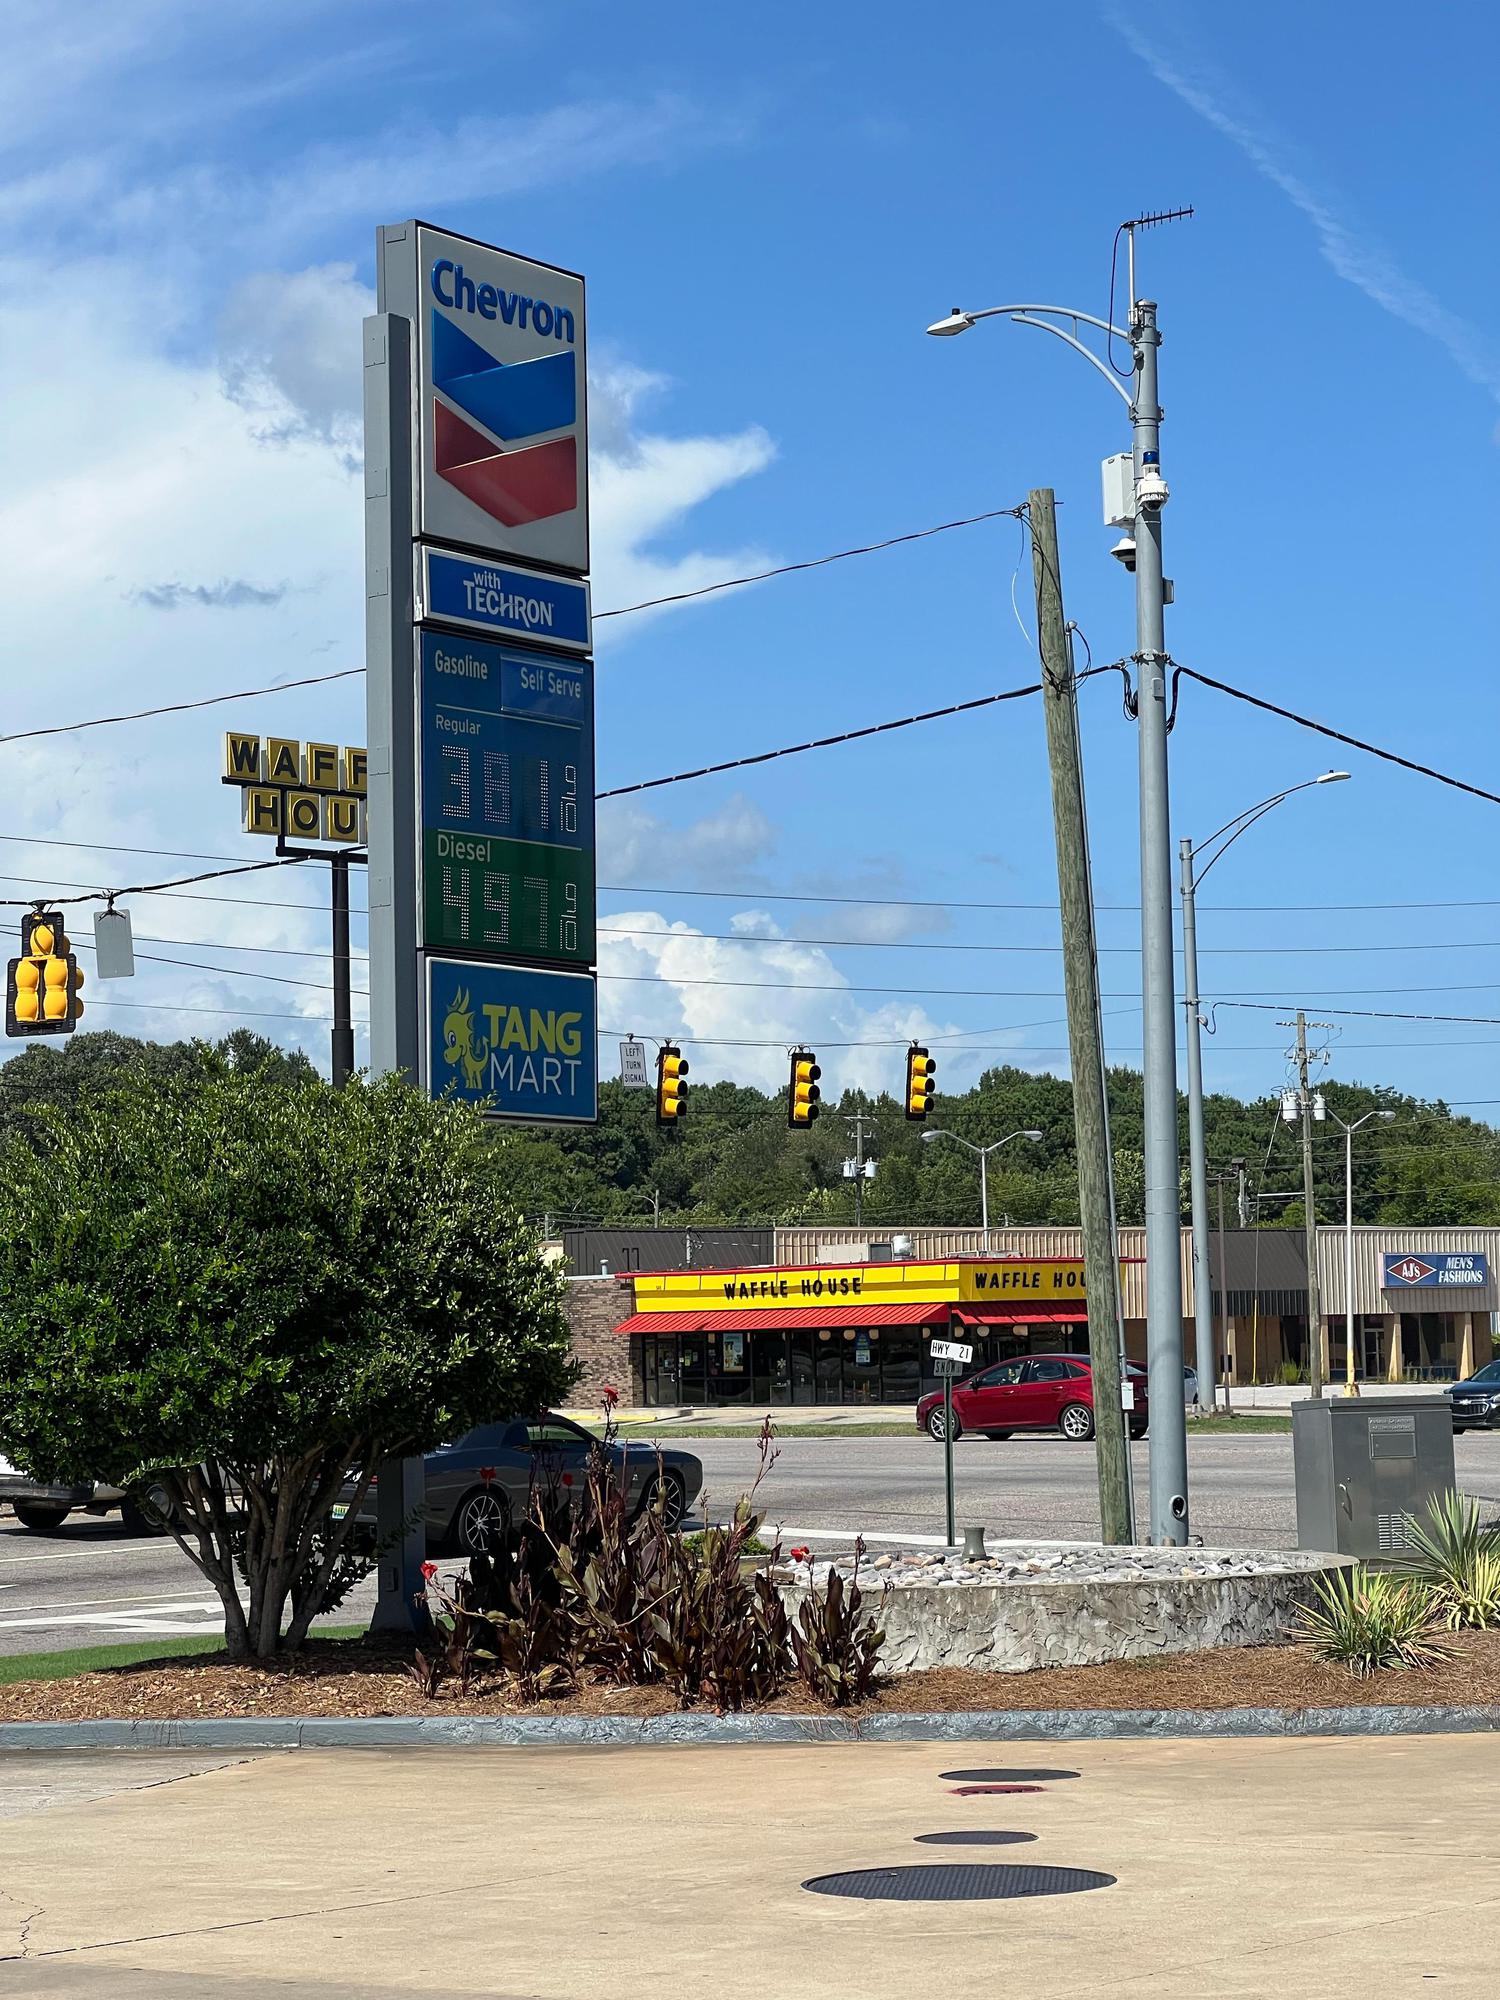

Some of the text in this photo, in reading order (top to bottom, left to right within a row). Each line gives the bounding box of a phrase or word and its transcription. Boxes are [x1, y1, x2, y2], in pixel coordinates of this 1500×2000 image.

[431, 259, 575, 343] Chevron
[473, 571, 500, 590] with
[463, 580, 553, 628] TECHRON
[435, 650, 488, 679] Gasoline
[520, 667, 581, 698] Self Serve
[436, 715, 480, 735] Regular
[437, 834, 491, 862] Diesel
[482, 1004, 582, 1056] TANG
[625, 1047, 640, 1056] LEFT
[490, 1052, 582, 1096] MART
[626, 1061, 641, 1069] TURN
[624, 1073, 645, 1083] SIGNAL
[1446, 1256, 1474, 1269] MEN'S
[975, 1272, 1041, 1289] WAFFLE
[1438, 1270, 1483, 1283] FASHIONS
[724, 1277, 862, 1300] WAFFLE HOUSE
[932, 1341, 969, 1359] HWY 21
